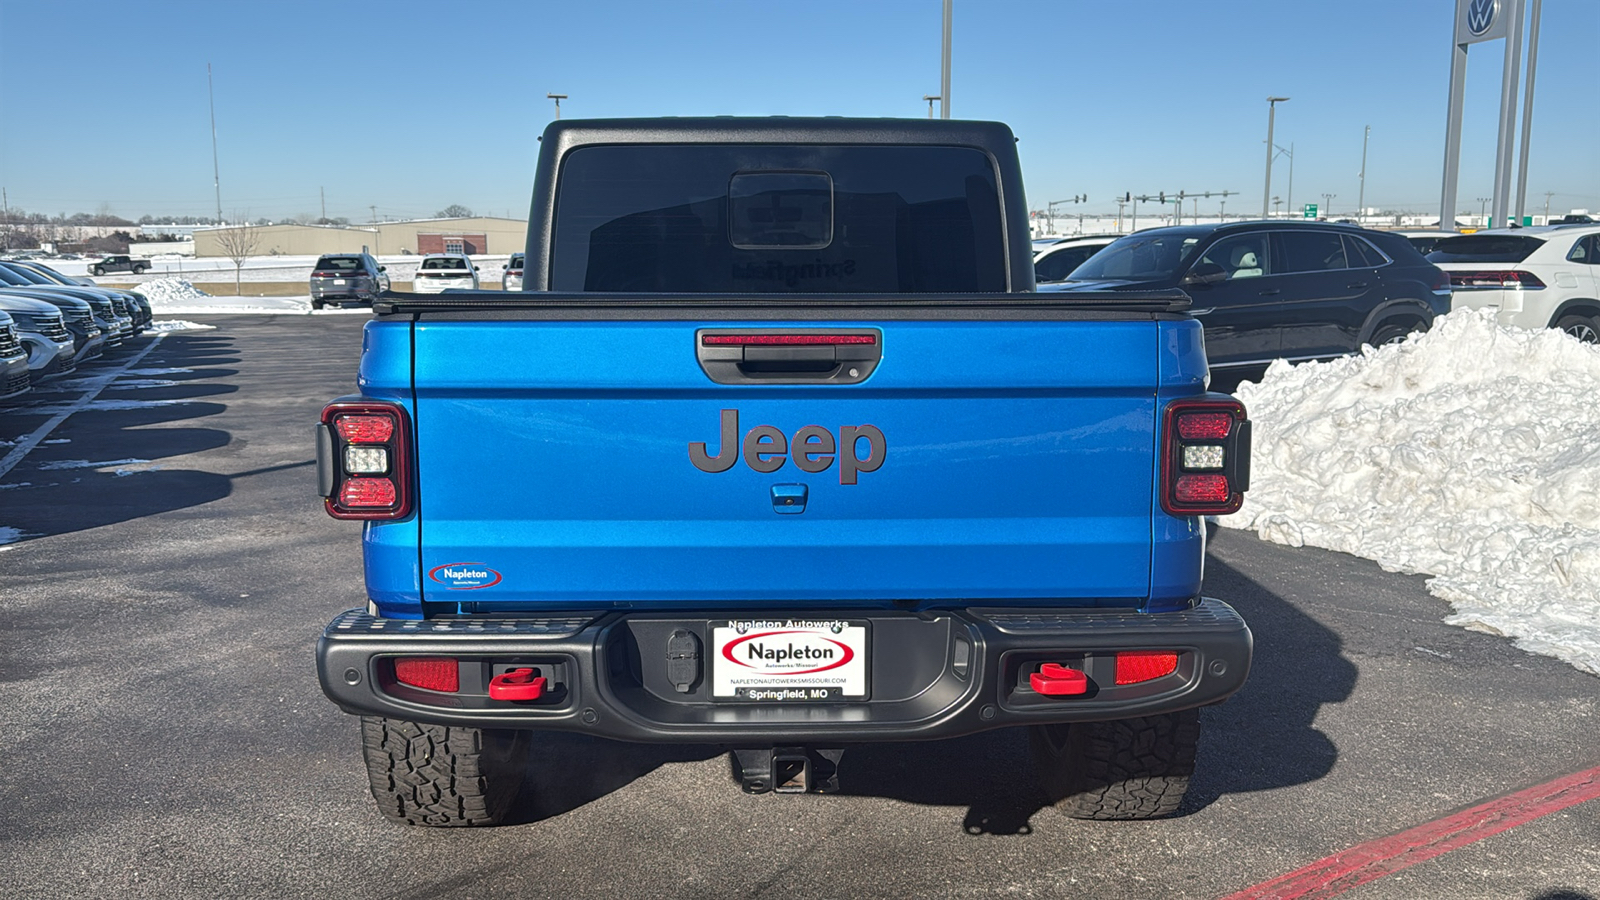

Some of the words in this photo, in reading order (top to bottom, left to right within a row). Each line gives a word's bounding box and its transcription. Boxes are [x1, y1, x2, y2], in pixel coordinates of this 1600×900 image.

[688, 409, 887, 485] Jeep
[444, 568, 487, 580] Napleton
[728, 620, 782, 630] Napleton
[785, 620, 849, 629] Autowerks
[748, 643, 833, 663] Napleton
[749, 689, 808, 700] Springfield,
[811, 689, 828, 698] MO
